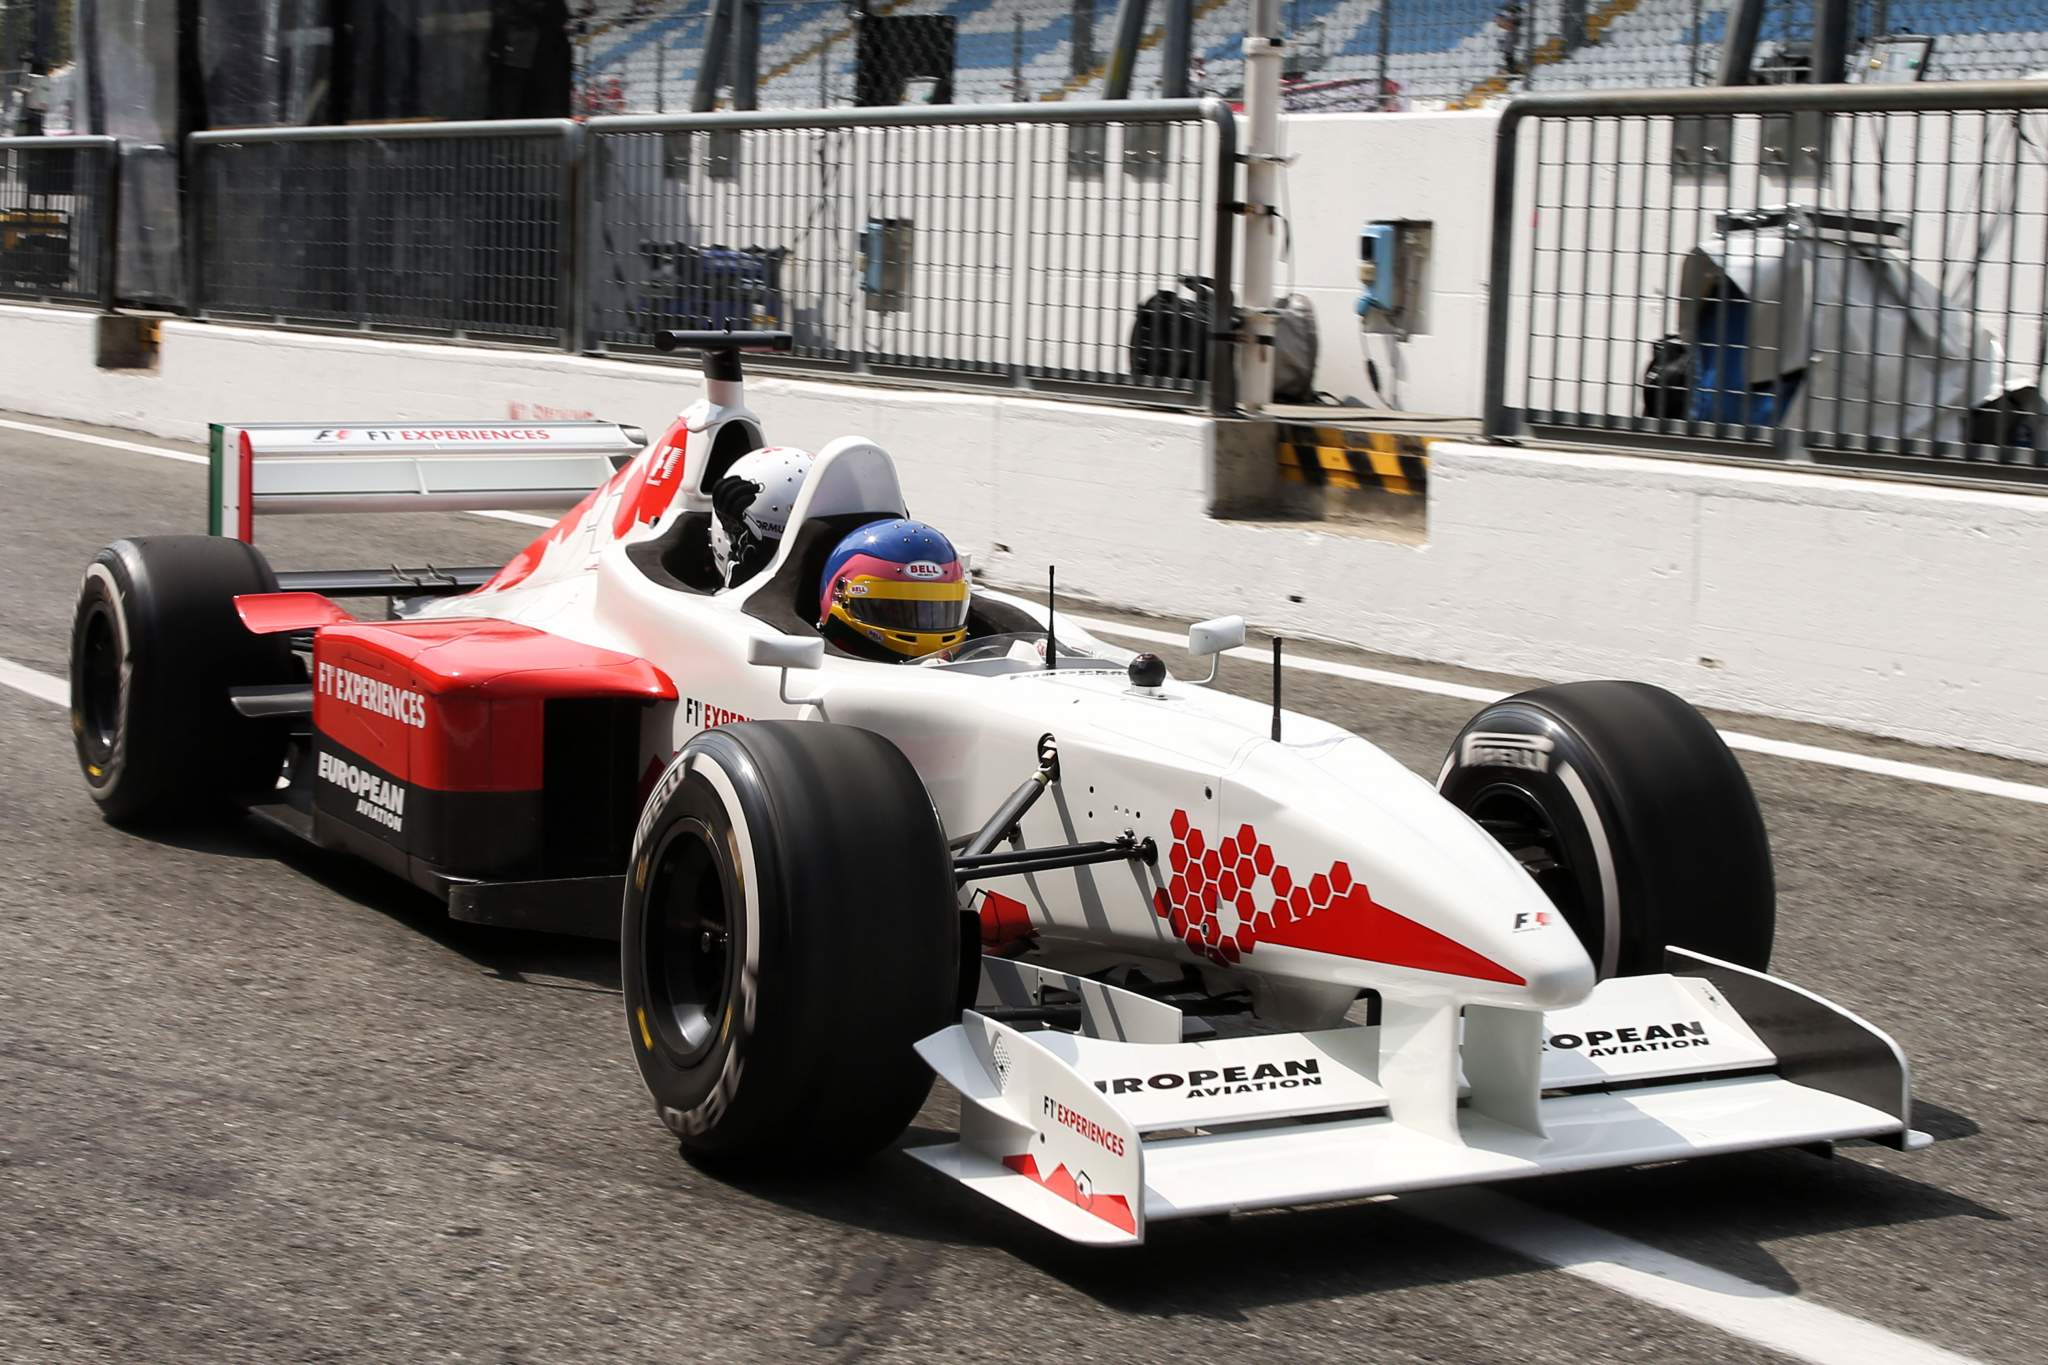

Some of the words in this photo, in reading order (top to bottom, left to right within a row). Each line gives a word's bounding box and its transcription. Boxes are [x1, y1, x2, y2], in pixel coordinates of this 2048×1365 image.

[400, 429, 551, 441] EXPERIENCES
[910, 564, 939, 574] BELL
[336, 667, 426, 729] EXPERIENCES
[318, 751, 406, 815] EUROPEAN
[356, 798, 403, 833] AVIATION
[1541, 1021, 1706, 1051] OPEAN
[1588, 1037, 1711, 1058] AVIATION
[1186, 1076, 1323, 1099] AVIATION
[1057, 1103, 1125, 1157] EXPERIENCES
